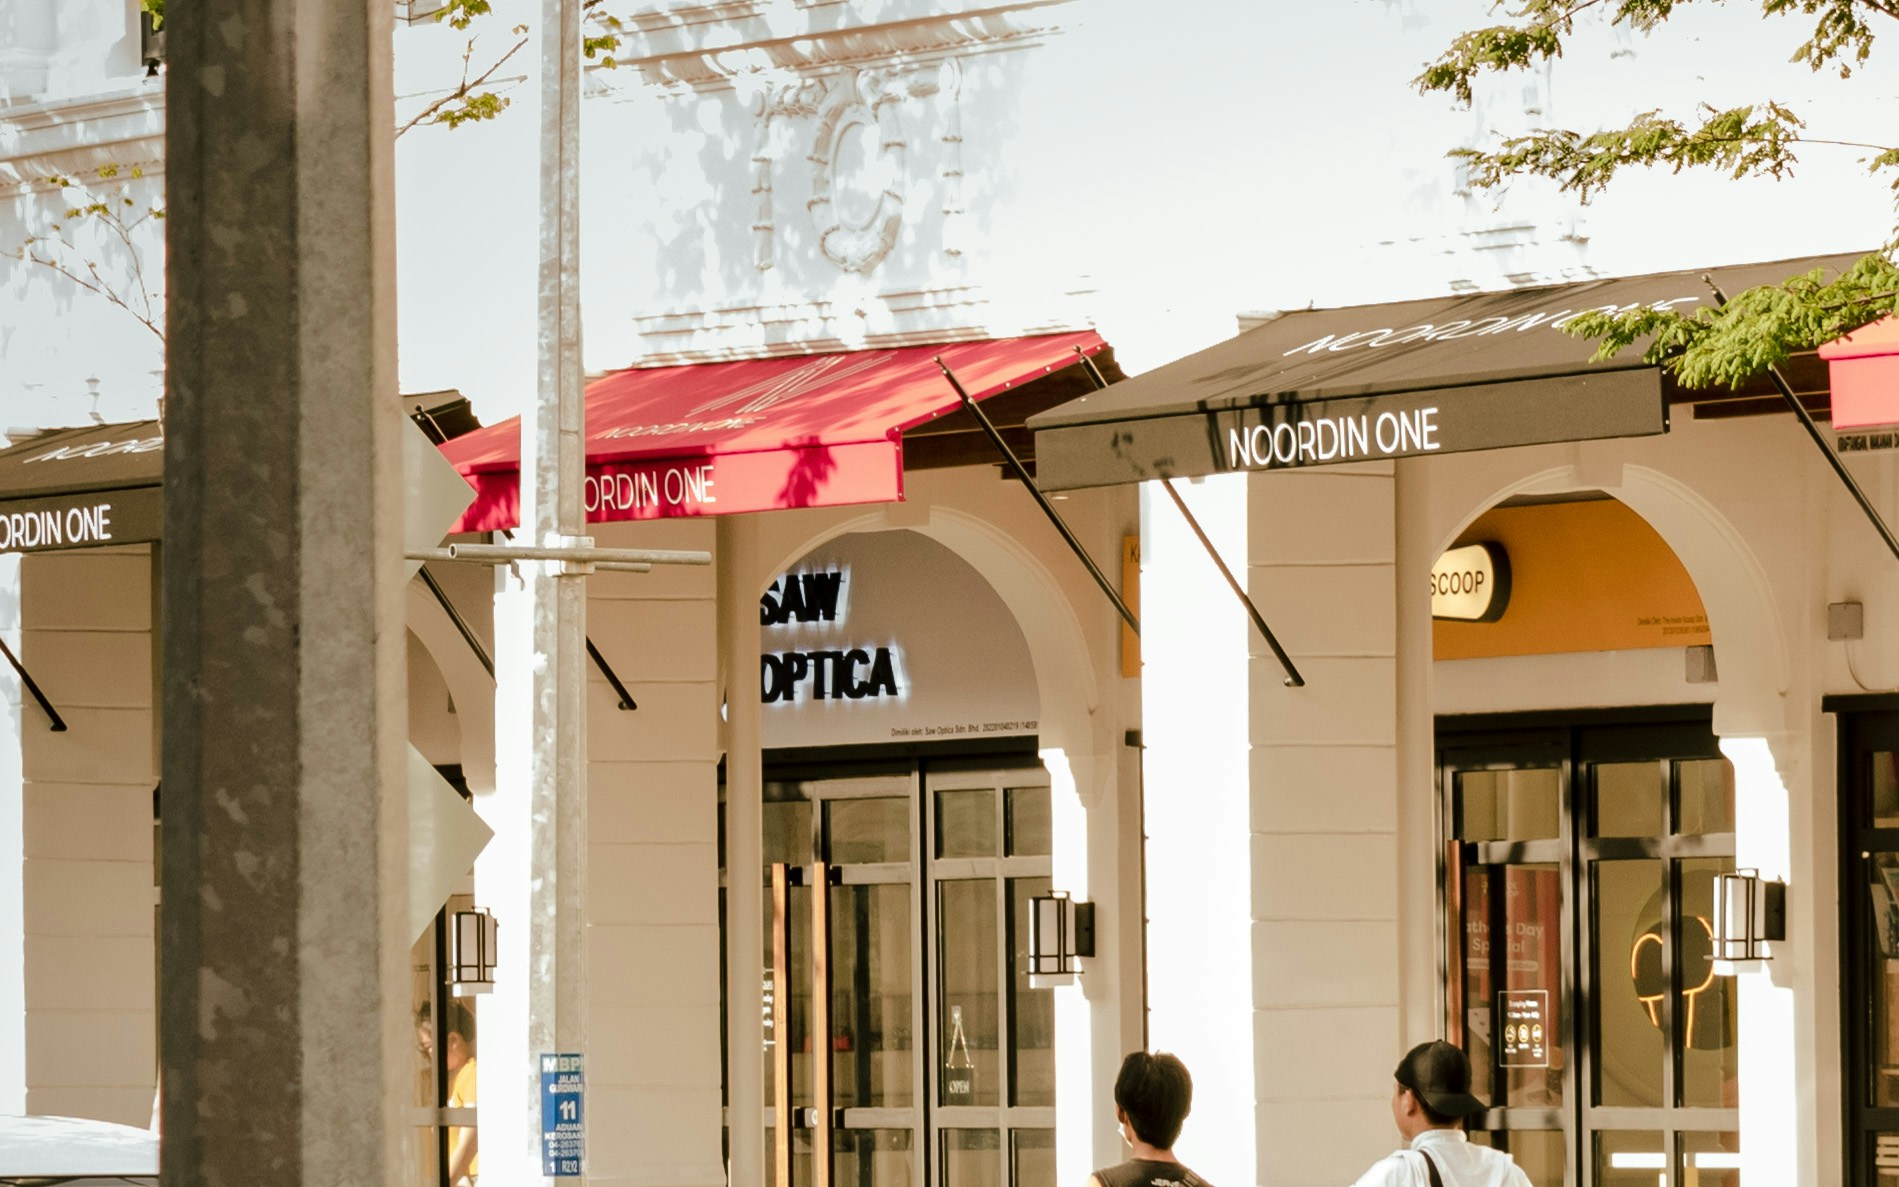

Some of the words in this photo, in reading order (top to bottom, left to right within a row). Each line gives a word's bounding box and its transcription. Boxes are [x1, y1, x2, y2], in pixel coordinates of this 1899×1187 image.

[1229, 418, 1370, 468] NOORDIN
[1375, 407, 1441, 453] ONE
[664, 465, 716, 505] ONE
[65, 503, 112, 543] ONE
[760, 571, 842, 626] SAW
[1431, 570, 1485, 596] SCOOP
[761, 647, 899, 703] OPTICA
[1516, 923, 1544, 939] Day
[559, 1101, 576, 1120] 11
